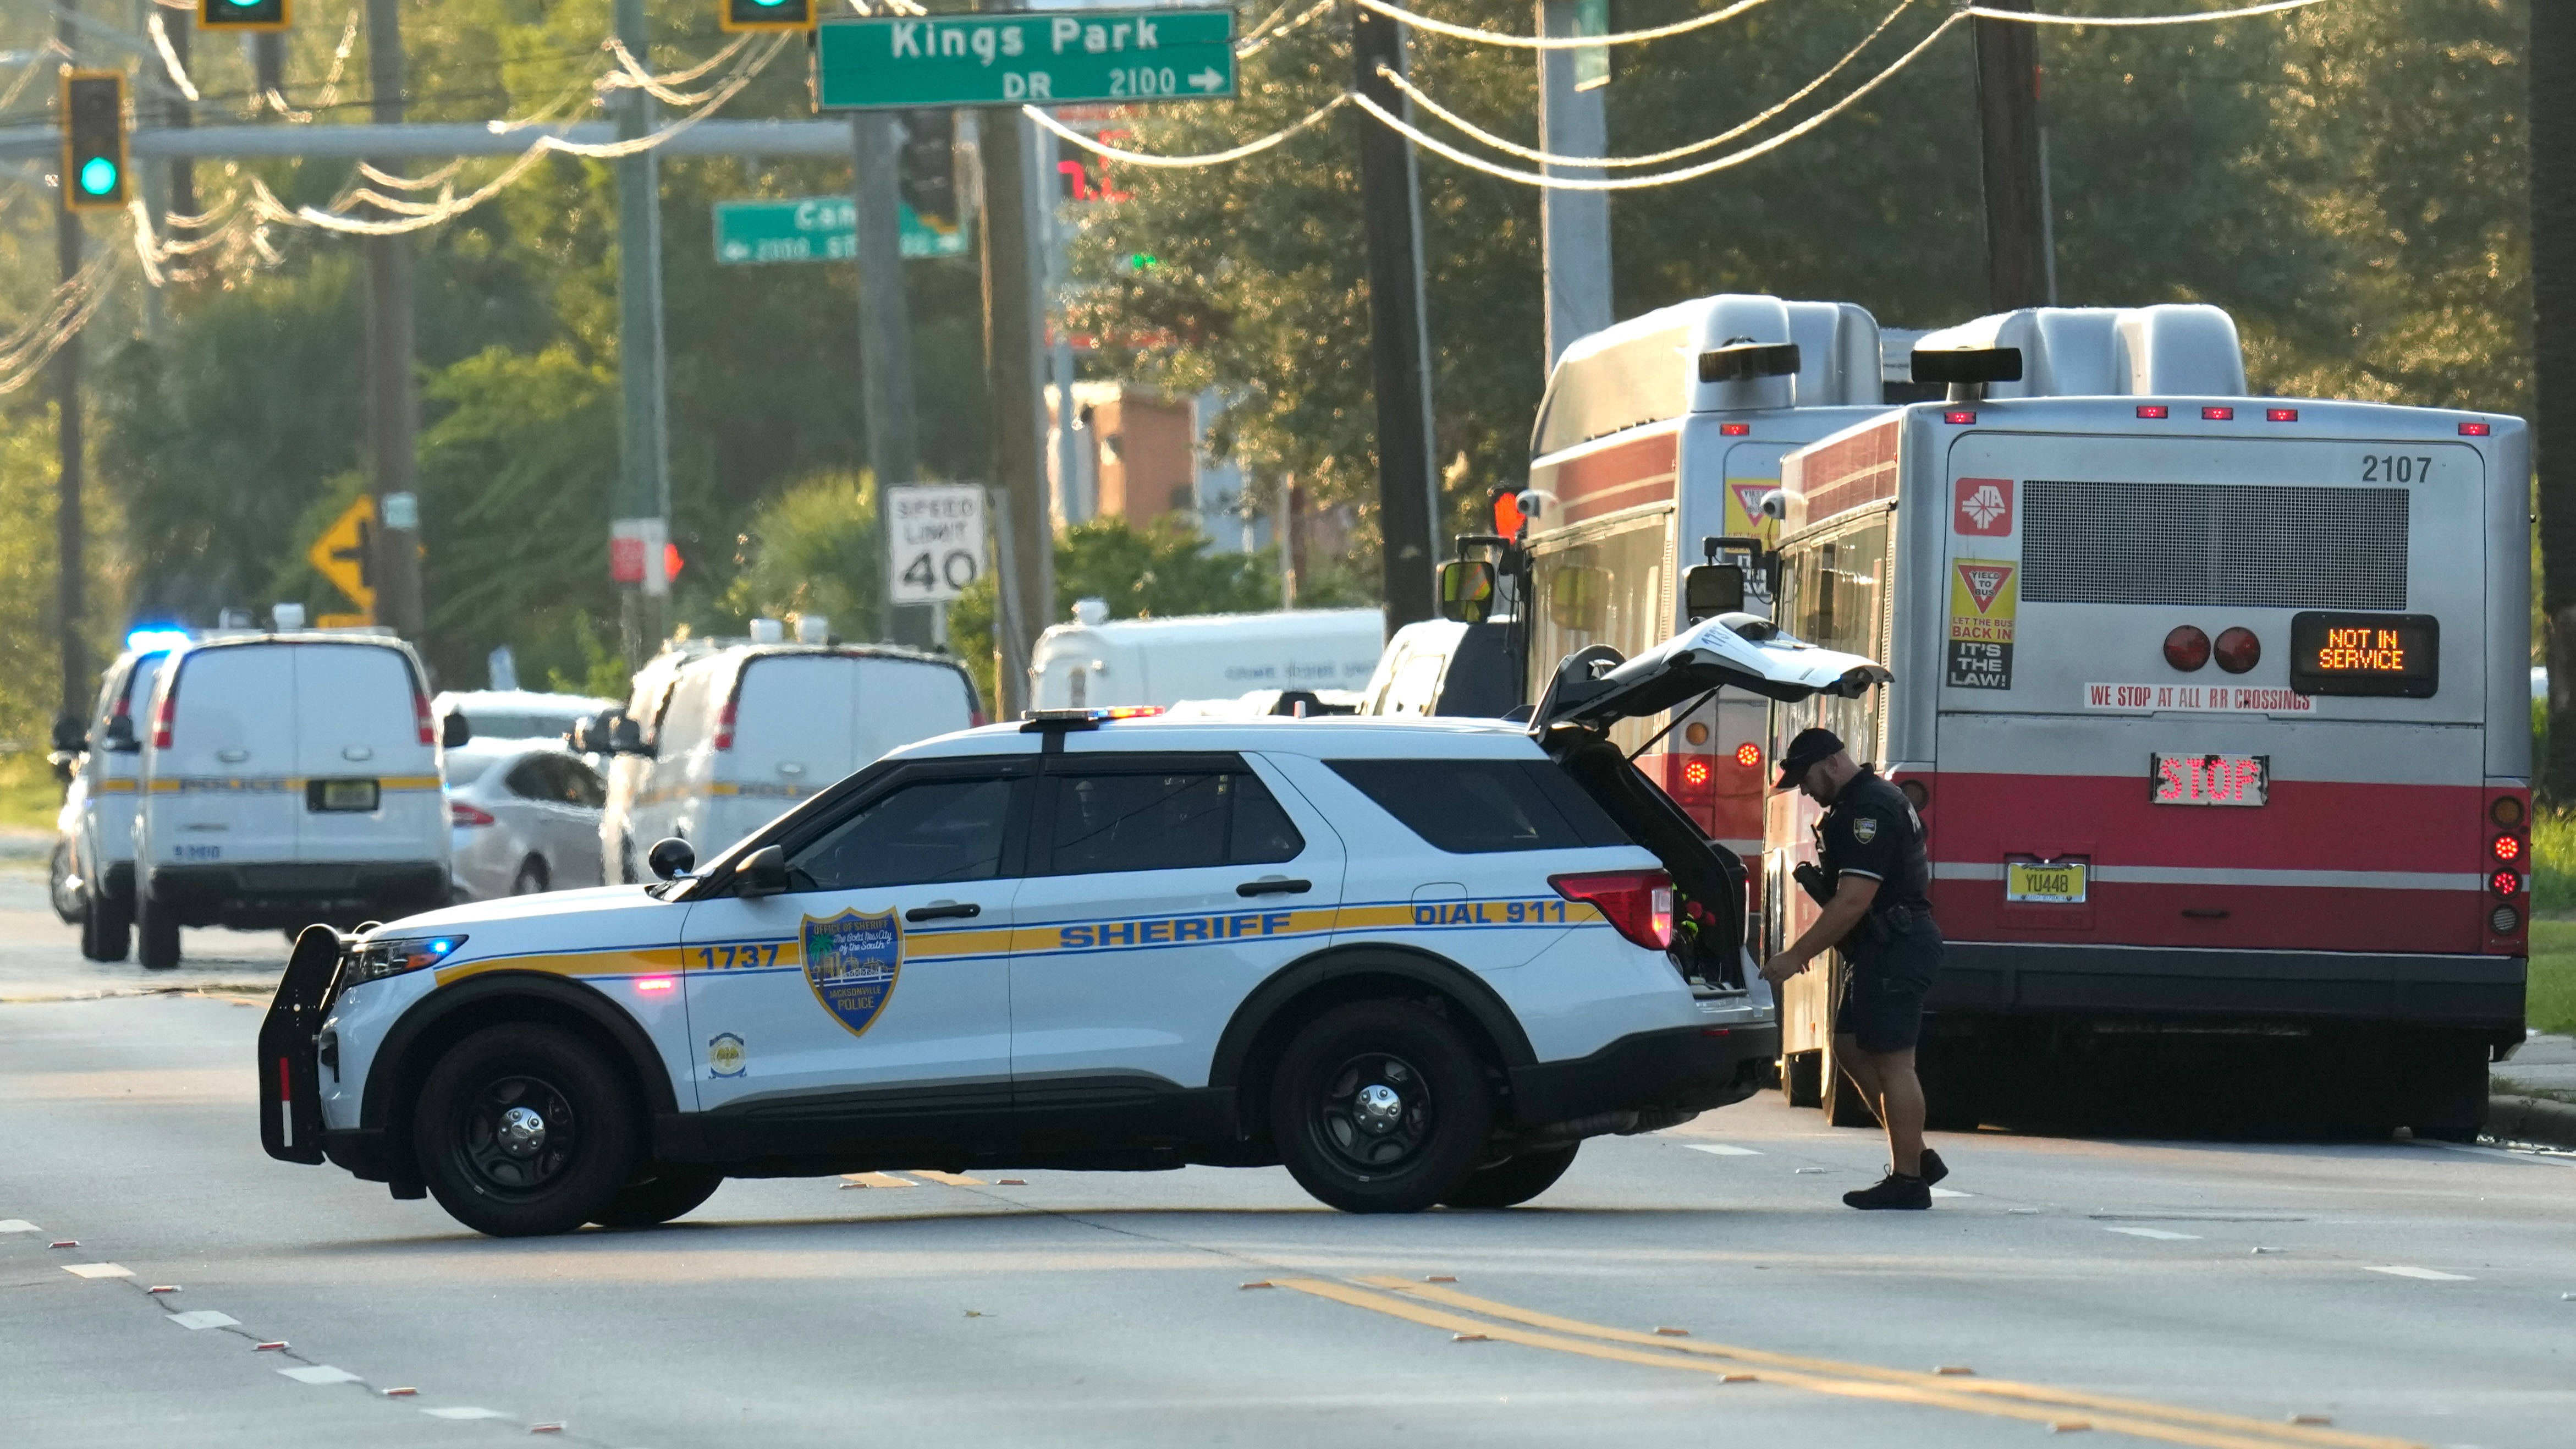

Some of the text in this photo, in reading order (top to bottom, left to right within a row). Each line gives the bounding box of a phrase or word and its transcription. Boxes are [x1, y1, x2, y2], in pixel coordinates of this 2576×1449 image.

[891, 18, 1158, 65] Kings Park
[1003, 68, 1175, 99] DR 2100
[2362, 455, 2432, 483] 2107
[904, 550, 977, 591] 40
[1972, 571, 2000, 579] YIELD
[1973, 618, 1991, 627] THE
[1953, 626, 2012, 640] BACK IN
[2329, 629, 2397, 649] NOT IN
[1961, 643, 2001, 657] IT'S
[2320, 649, 2404, 669] SERVICE
[1957, 657, 2002, 672] THE
[1951, 672, 2006, 687] LAW!
[2091, 685, 2310, 710] WE STOP AT ALL RR CROSSINGS
[2160, 758, 2258, 800] STOP
[2026, 874, 2068, 892] YU448
[1416, 901, 1565, 925] DIAL 911
[814, 920, 889, 934] OFFICE OF SHERIFF
[1060, 913, 1291, 948] SHERIFF
[833, 934, 846, 943] The
[847, 932, 863, 942] Bold
[839, 941, 885, 955] of the South
[698, 945, 778, 970] 1737
[830, 985, 881, 998] JACKSONVILLE
[838, 996, 874, 1011] POLICE
